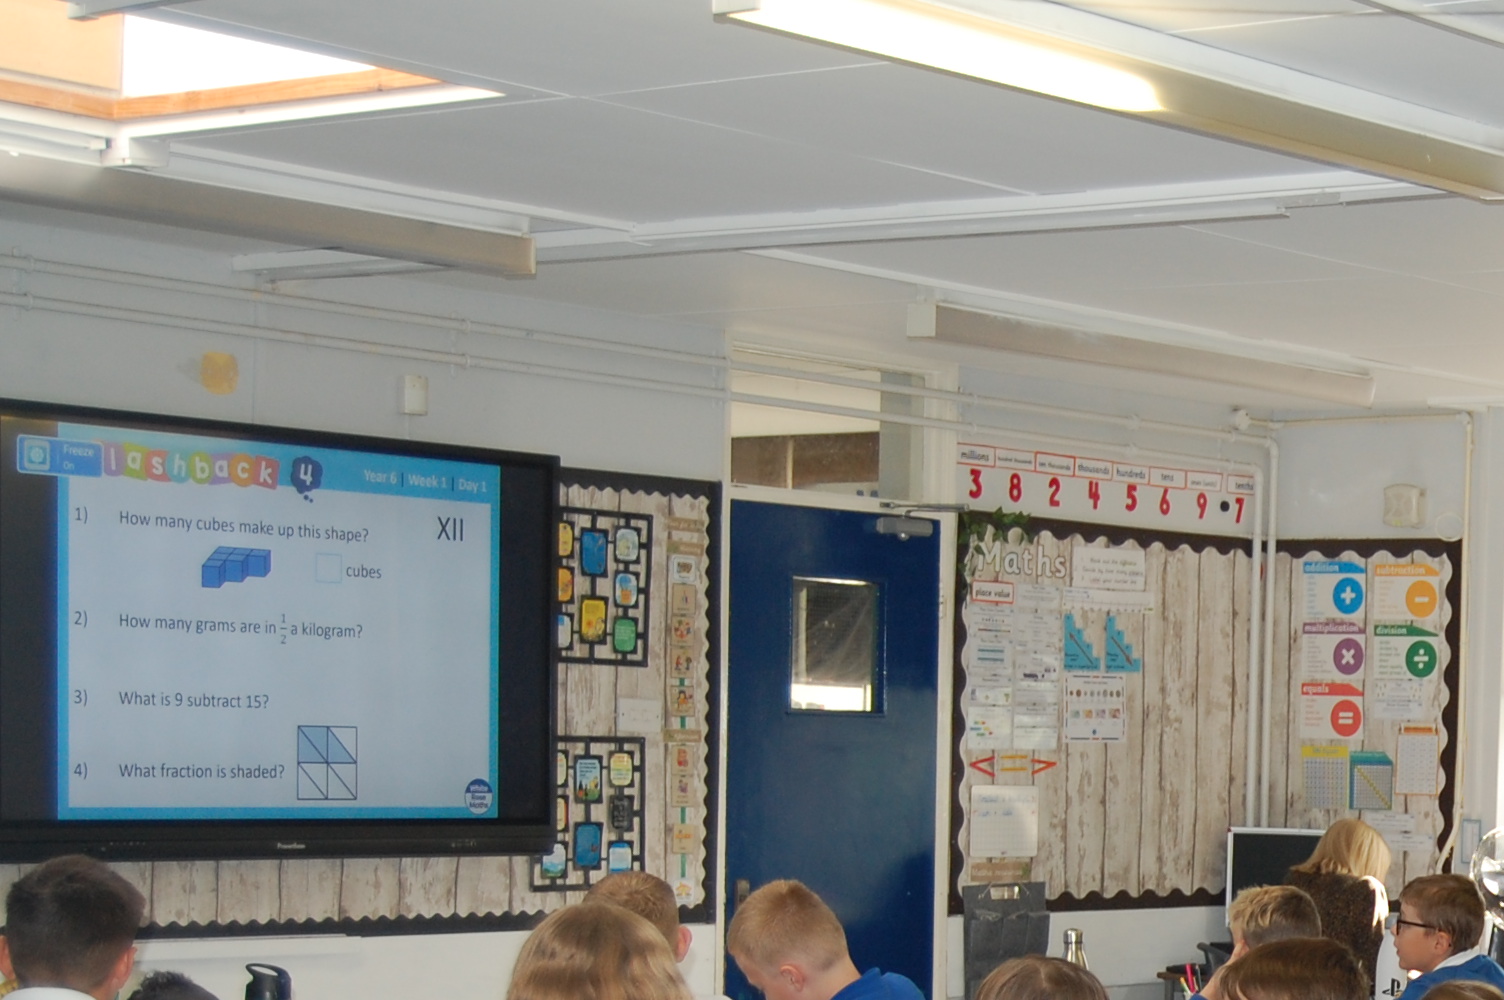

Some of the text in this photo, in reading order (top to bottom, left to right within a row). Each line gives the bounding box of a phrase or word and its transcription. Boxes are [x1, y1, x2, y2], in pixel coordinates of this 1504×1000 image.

[63, 444, 94, 457] Freeze
[961, 449, 989, 462] millions
[63, 462, 75, 471] On
[108, 447, 313, 486] lashback 4
[1078, 464, 1109, 475] thousands
[364, 469, 487, 493] Year 6 Week 1 Day 1
[1116, 469, 1146, 480] hundreds
[1161, 473, 1174, 482] tens
[969, 468, 1245, 524] 3 8 2 4 5 6 9 7
[75, 506, 369, 544] 1) How many cubes make up this shape?
[437, 516, 464, 541] XII
[976, 540, 1067, 579] Maths
[346, 564, 382, 579] cubes
[1305, 563, 1339, 572] addition
[1376, 565, 1426, 575] subtraction
[975, 588, 1011, 600] place value
[74, 611, 88, 628] 2)
[119, 613, 150, 629] How
[155, 617, 191, 633] many
[196, 619, 236, 635] grams
[240, 622, 260, 634] are
[265, 621, 277, 634] in
[290, 626, 298, 636] a
[301, 621, 363, 639] kilogram?
[1304, 623, 1359, 634] multiplication
[1376, 625, 1407, 635] division
[1303, 684, 1329, 695] equals
[74, 689, 269, 708] 3) What is 9 subtract 15?
[74, 762, 285, 779] 4) What fraction is shaded?
